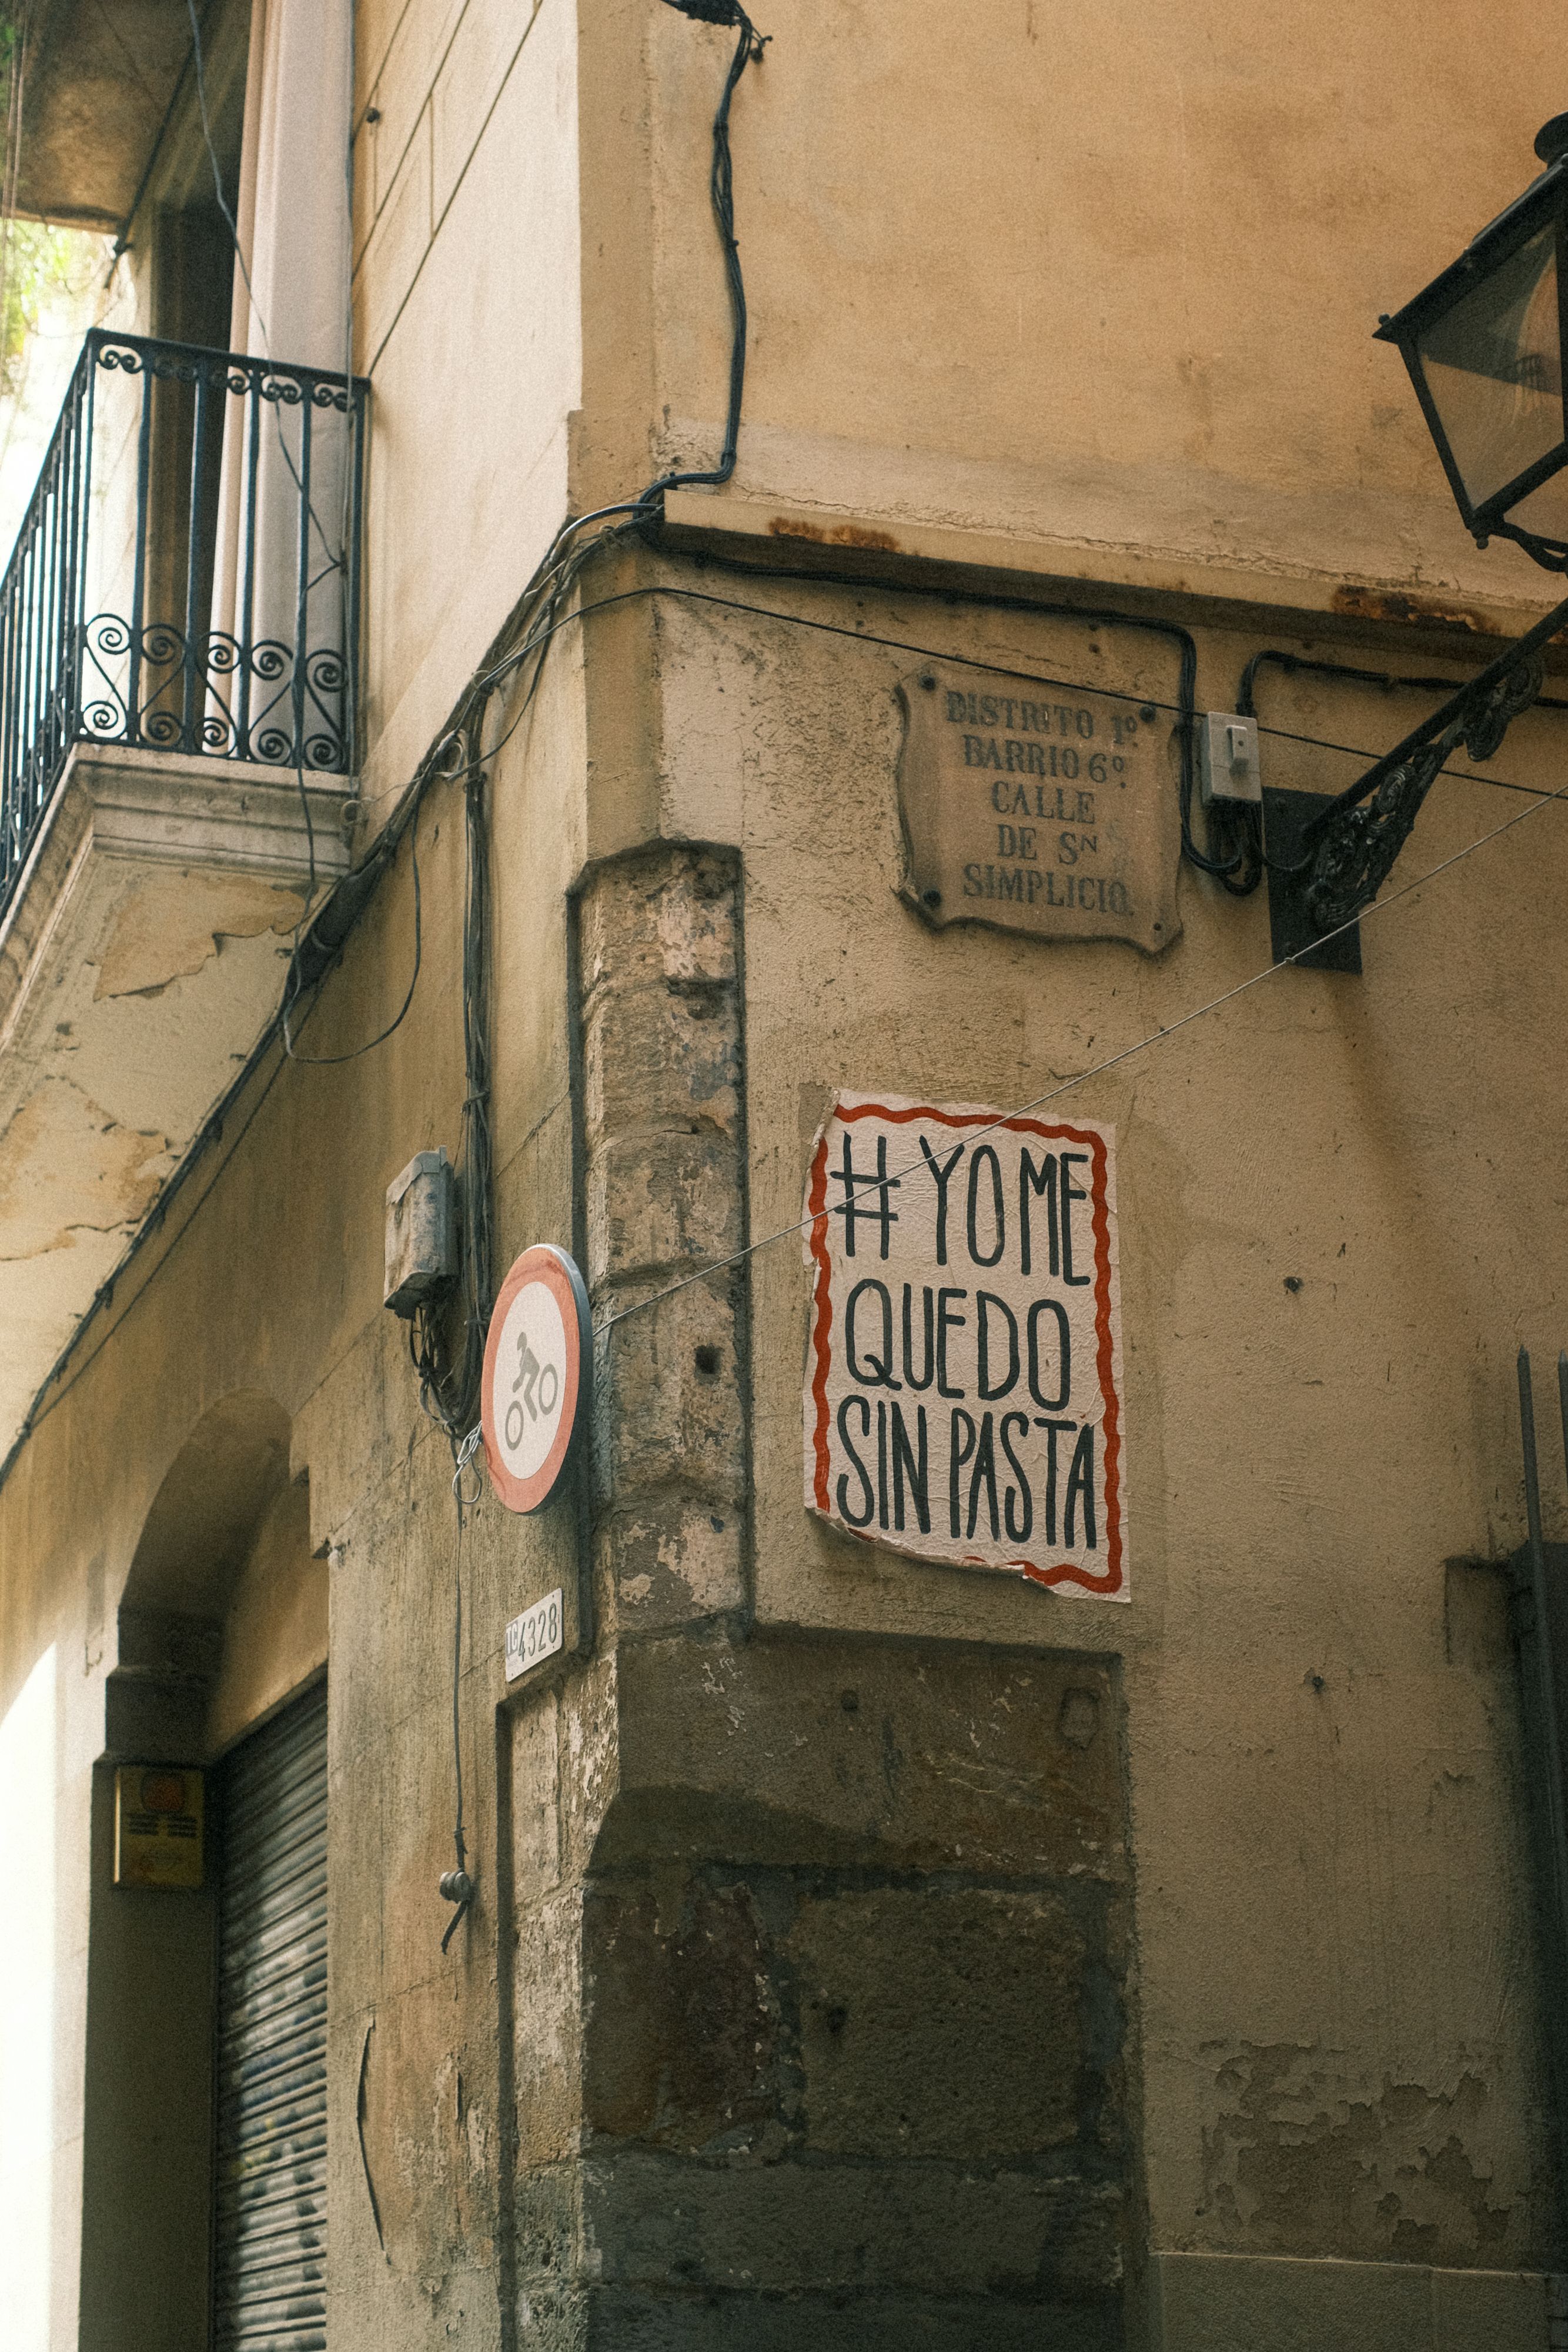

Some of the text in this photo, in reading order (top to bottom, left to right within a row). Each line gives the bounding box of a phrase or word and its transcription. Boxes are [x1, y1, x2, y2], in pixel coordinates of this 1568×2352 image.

[946, 690, 1094, 739] DISTRITO
[962, 734, 1079, 780] BARRIO
[991, 780, 1095, 824] CALLE
[997, 824, 1038, 860] DE
[845, 1278, 1070, 1411] QUEDO
[837, 1394, 1097, 1549] SIN PASTA
[518, 1603, 557, 1662] 4328
